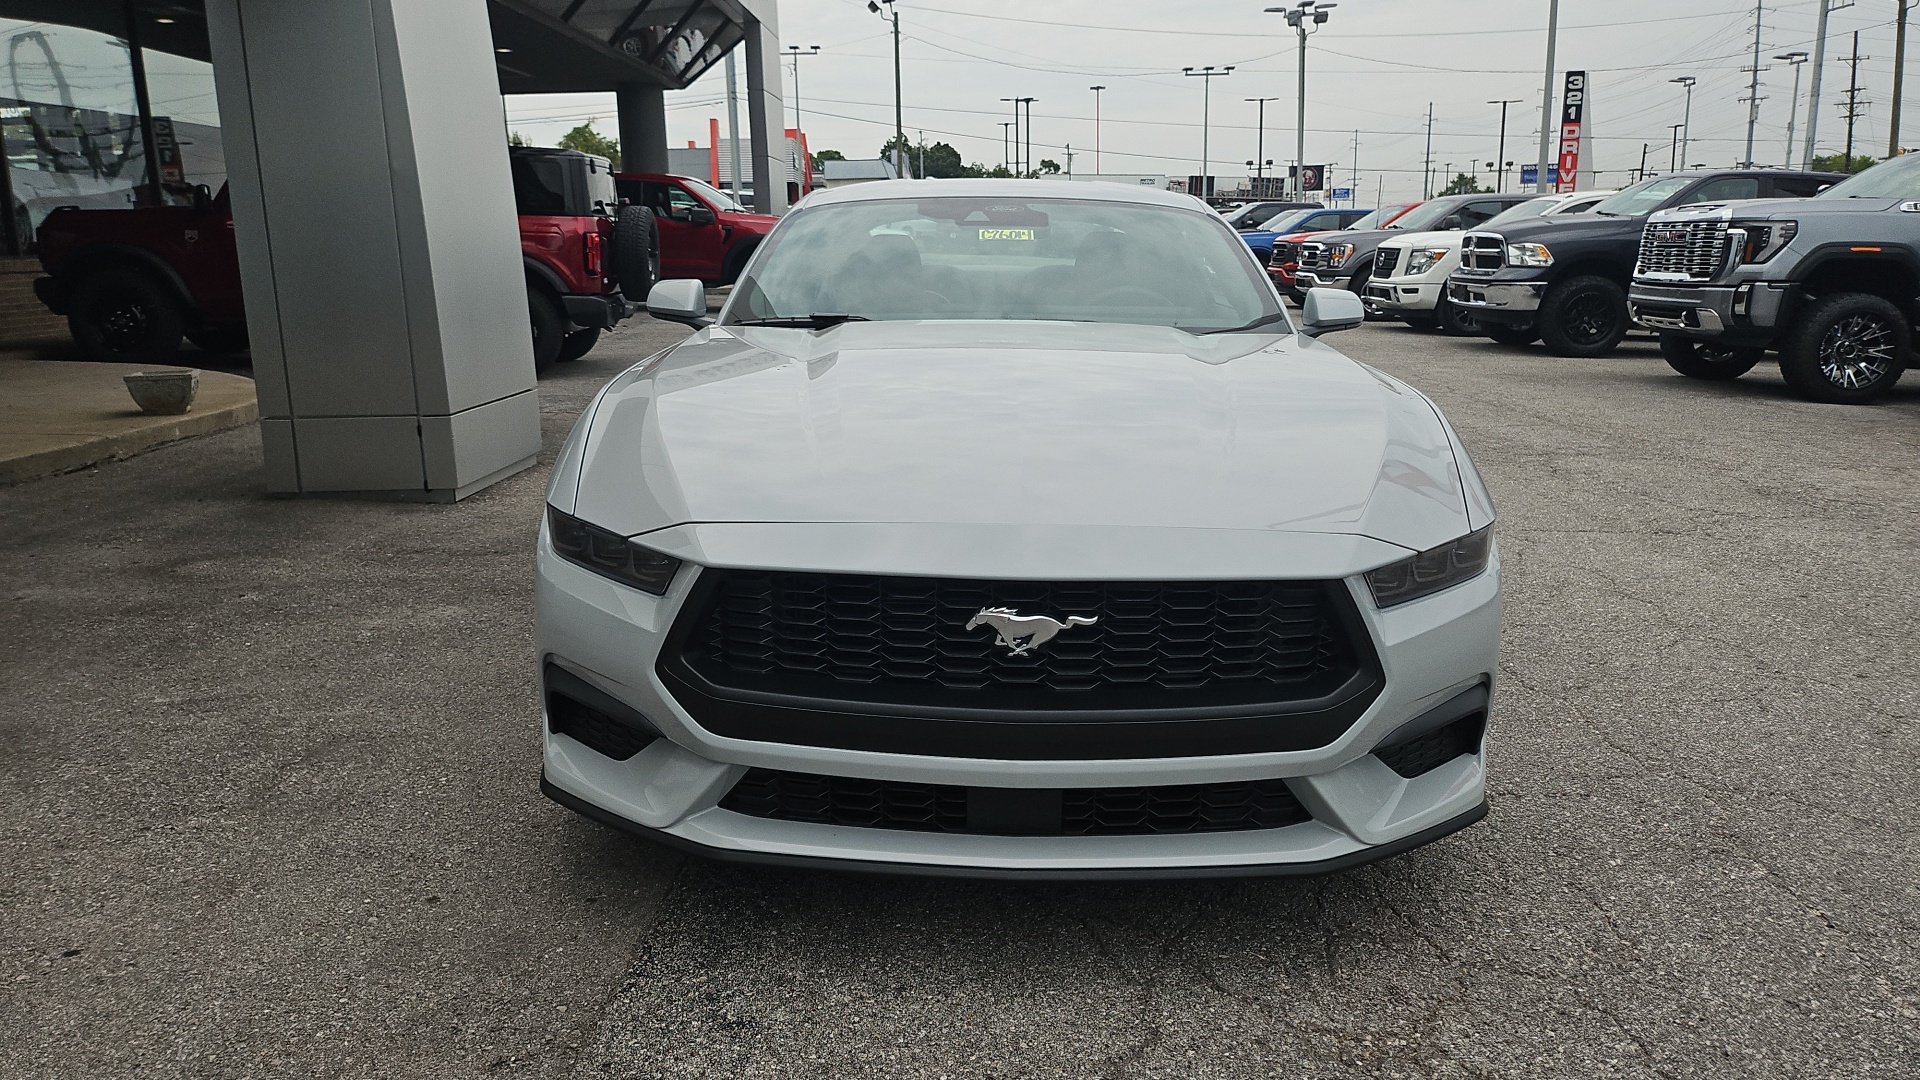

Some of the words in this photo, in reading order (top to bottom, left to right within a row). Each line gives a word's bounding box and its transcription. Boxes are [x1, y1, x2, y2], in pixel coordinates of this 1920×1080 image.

[1566, 75, 1583, 119] 321
[1559, 126, 1579, 193] DRIVE
[1656, 231, 1687, 242] GMC
